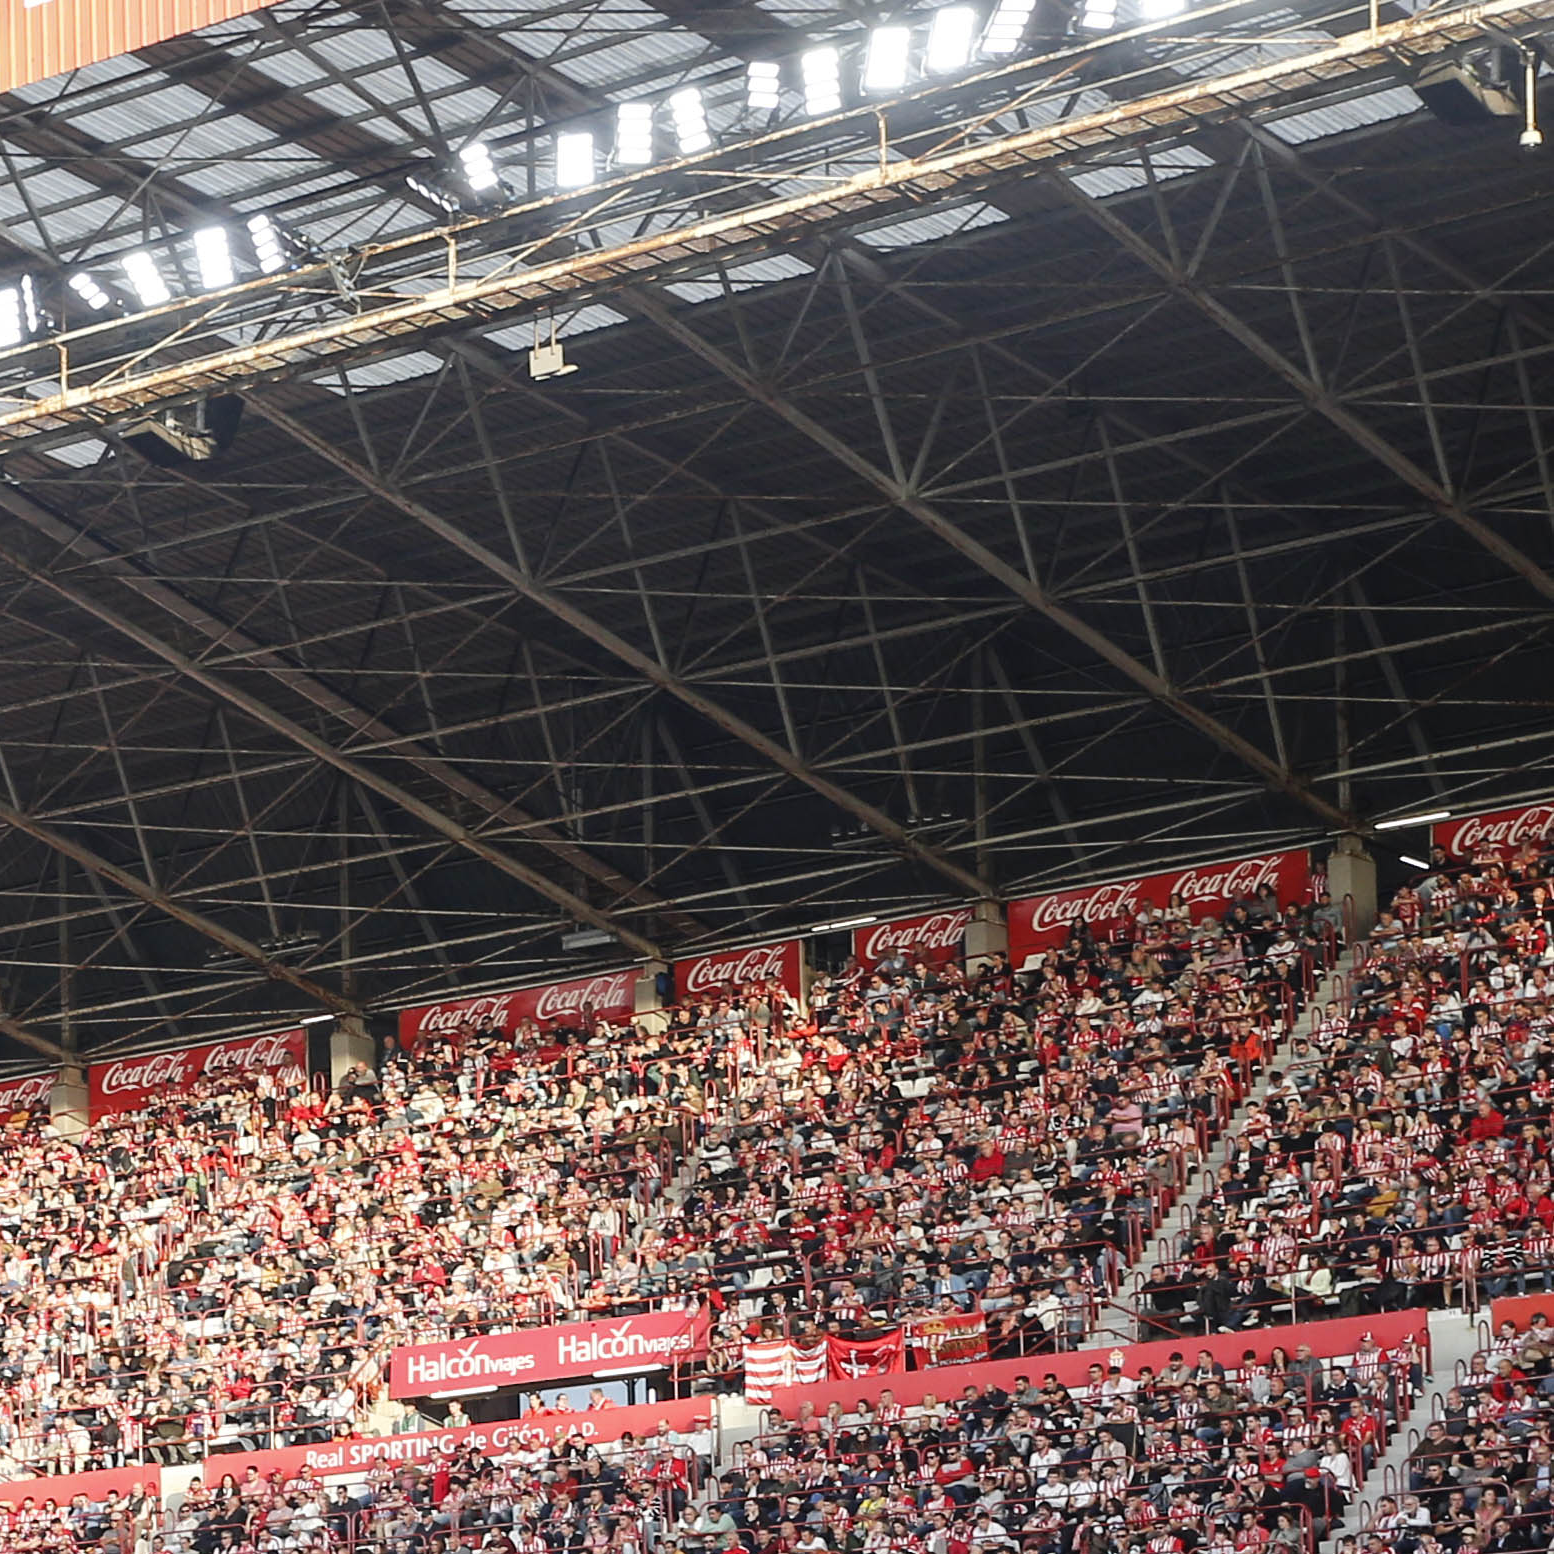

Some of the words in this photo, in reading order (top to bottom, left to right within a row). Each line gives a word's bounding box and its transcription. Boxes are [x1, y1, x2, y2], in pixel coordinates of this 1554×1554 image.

[865, 911, 973, 960] Coca-Cola
[686, 944, 787, 992] Coca-Cola
[535, 974, 628, 1021] Coca-Cola
[101, 1051, 189, 1095] Coca-Cola
[305, 1445, 343, 1469] Real
[349, 1433, 455, 1466] SPORTING
[463, 1431, 487, 1451] de
